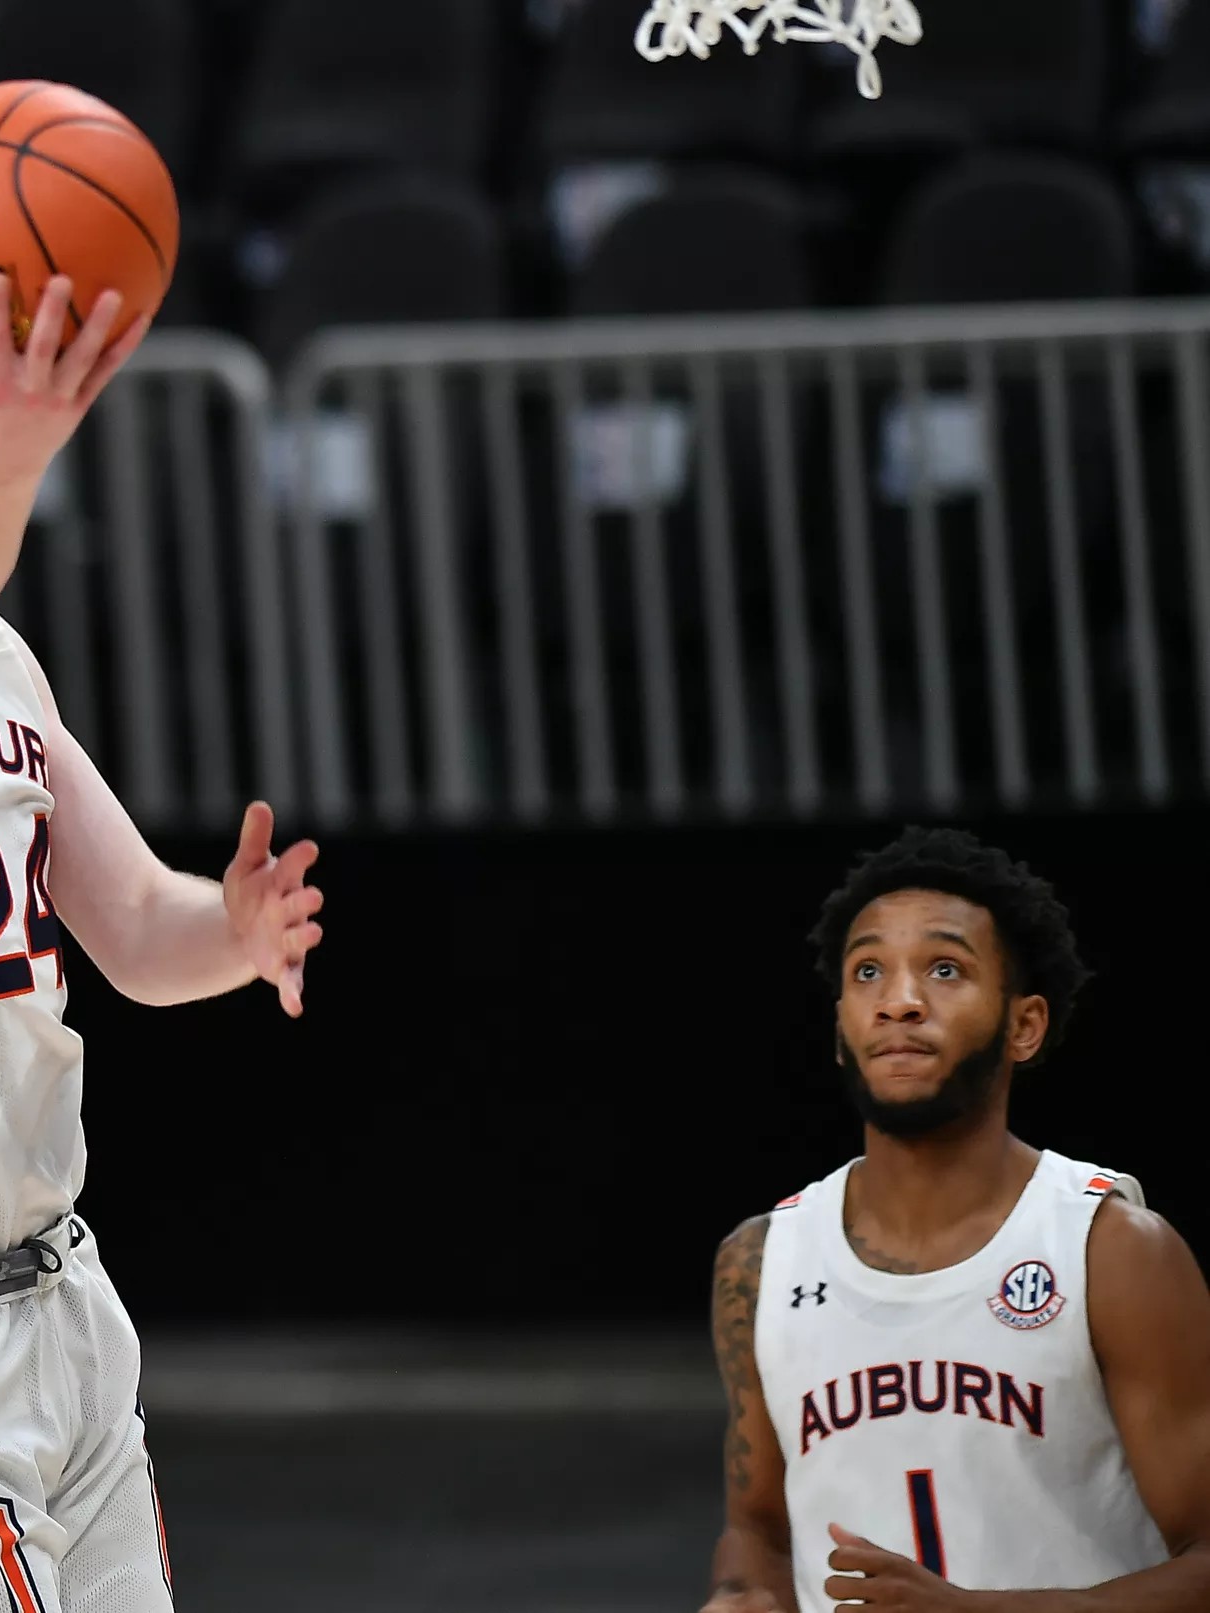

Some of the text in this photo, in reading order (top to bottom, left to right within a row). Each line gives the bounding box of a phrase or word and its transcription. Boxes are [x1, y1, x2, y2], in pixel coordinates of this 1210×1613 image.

[1005, 1262, 1052, 1311] SEC
[799, 1359, 1046, 1457] AUBURN
[904, 1468, 948, 1580] 1
